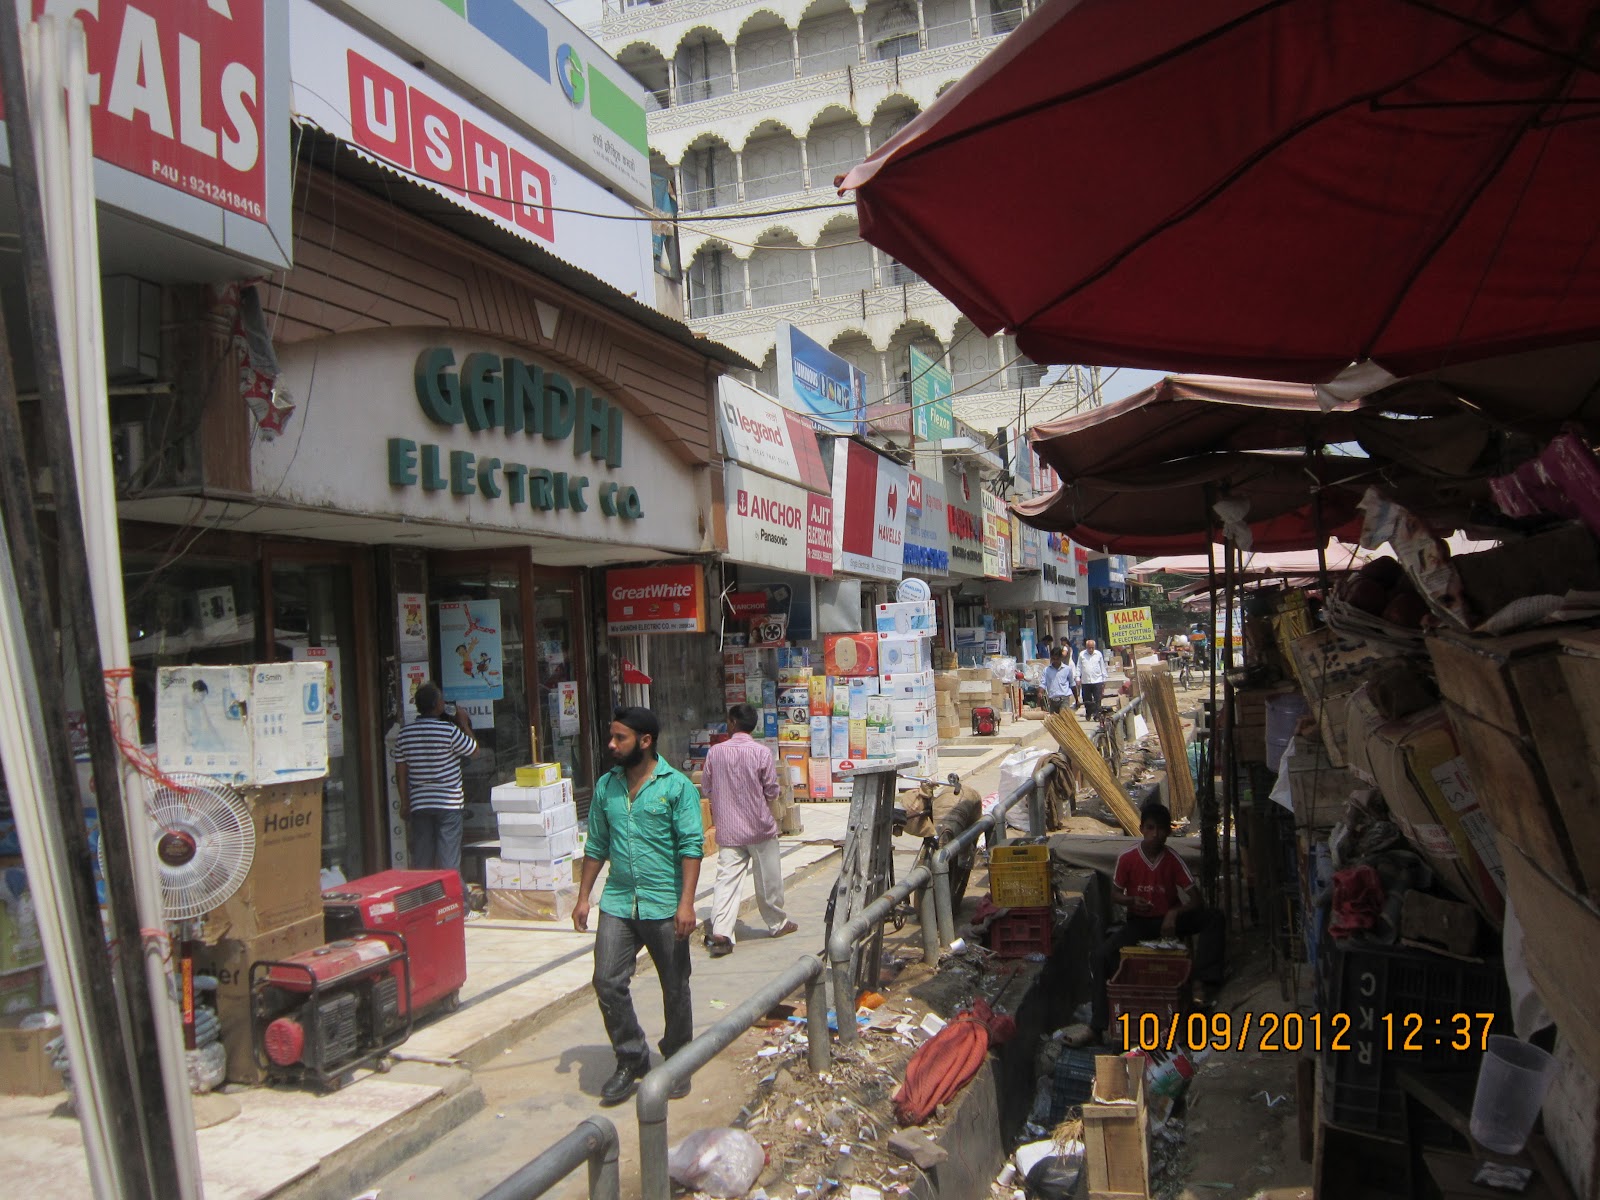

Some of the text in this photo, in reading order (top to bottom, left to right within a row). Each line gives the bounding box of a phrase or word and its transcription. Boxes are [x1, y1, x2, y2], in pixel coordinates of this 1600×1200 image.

[45, 0, 259, 172] ALS
[362, 74, 546, 225] USHA
[152, 160, 179, 184] P4U
[415, 346, 623, 469] GANDHI
[736, 407, 784, 447] legrand
[388, 437, 645, 520] ELECTRIC CO.
[750, 497, 802, 530] ANCHOR
[810, 503, 831, 526] AJIT
[760, 528, 788, 547] Panasonic
[878, 523, 902, 546] HAVELLS
[612, 583, 692, 601] GreatWhite
[638, 623, 661, 631] ELECTRIC
[1113, 609, 1145, 625] KALRA
[1118, 622, 1143, 630] BAKELITE
[1111, 628, 1152, 638] SHEET CUTTING
[1118, 634, 1152, 643] ELECTRICALS
[264, 673, 282, 682] Smith
[263, 809, 312, 833] Haier
[438, 902, 459, 915] HONDA
